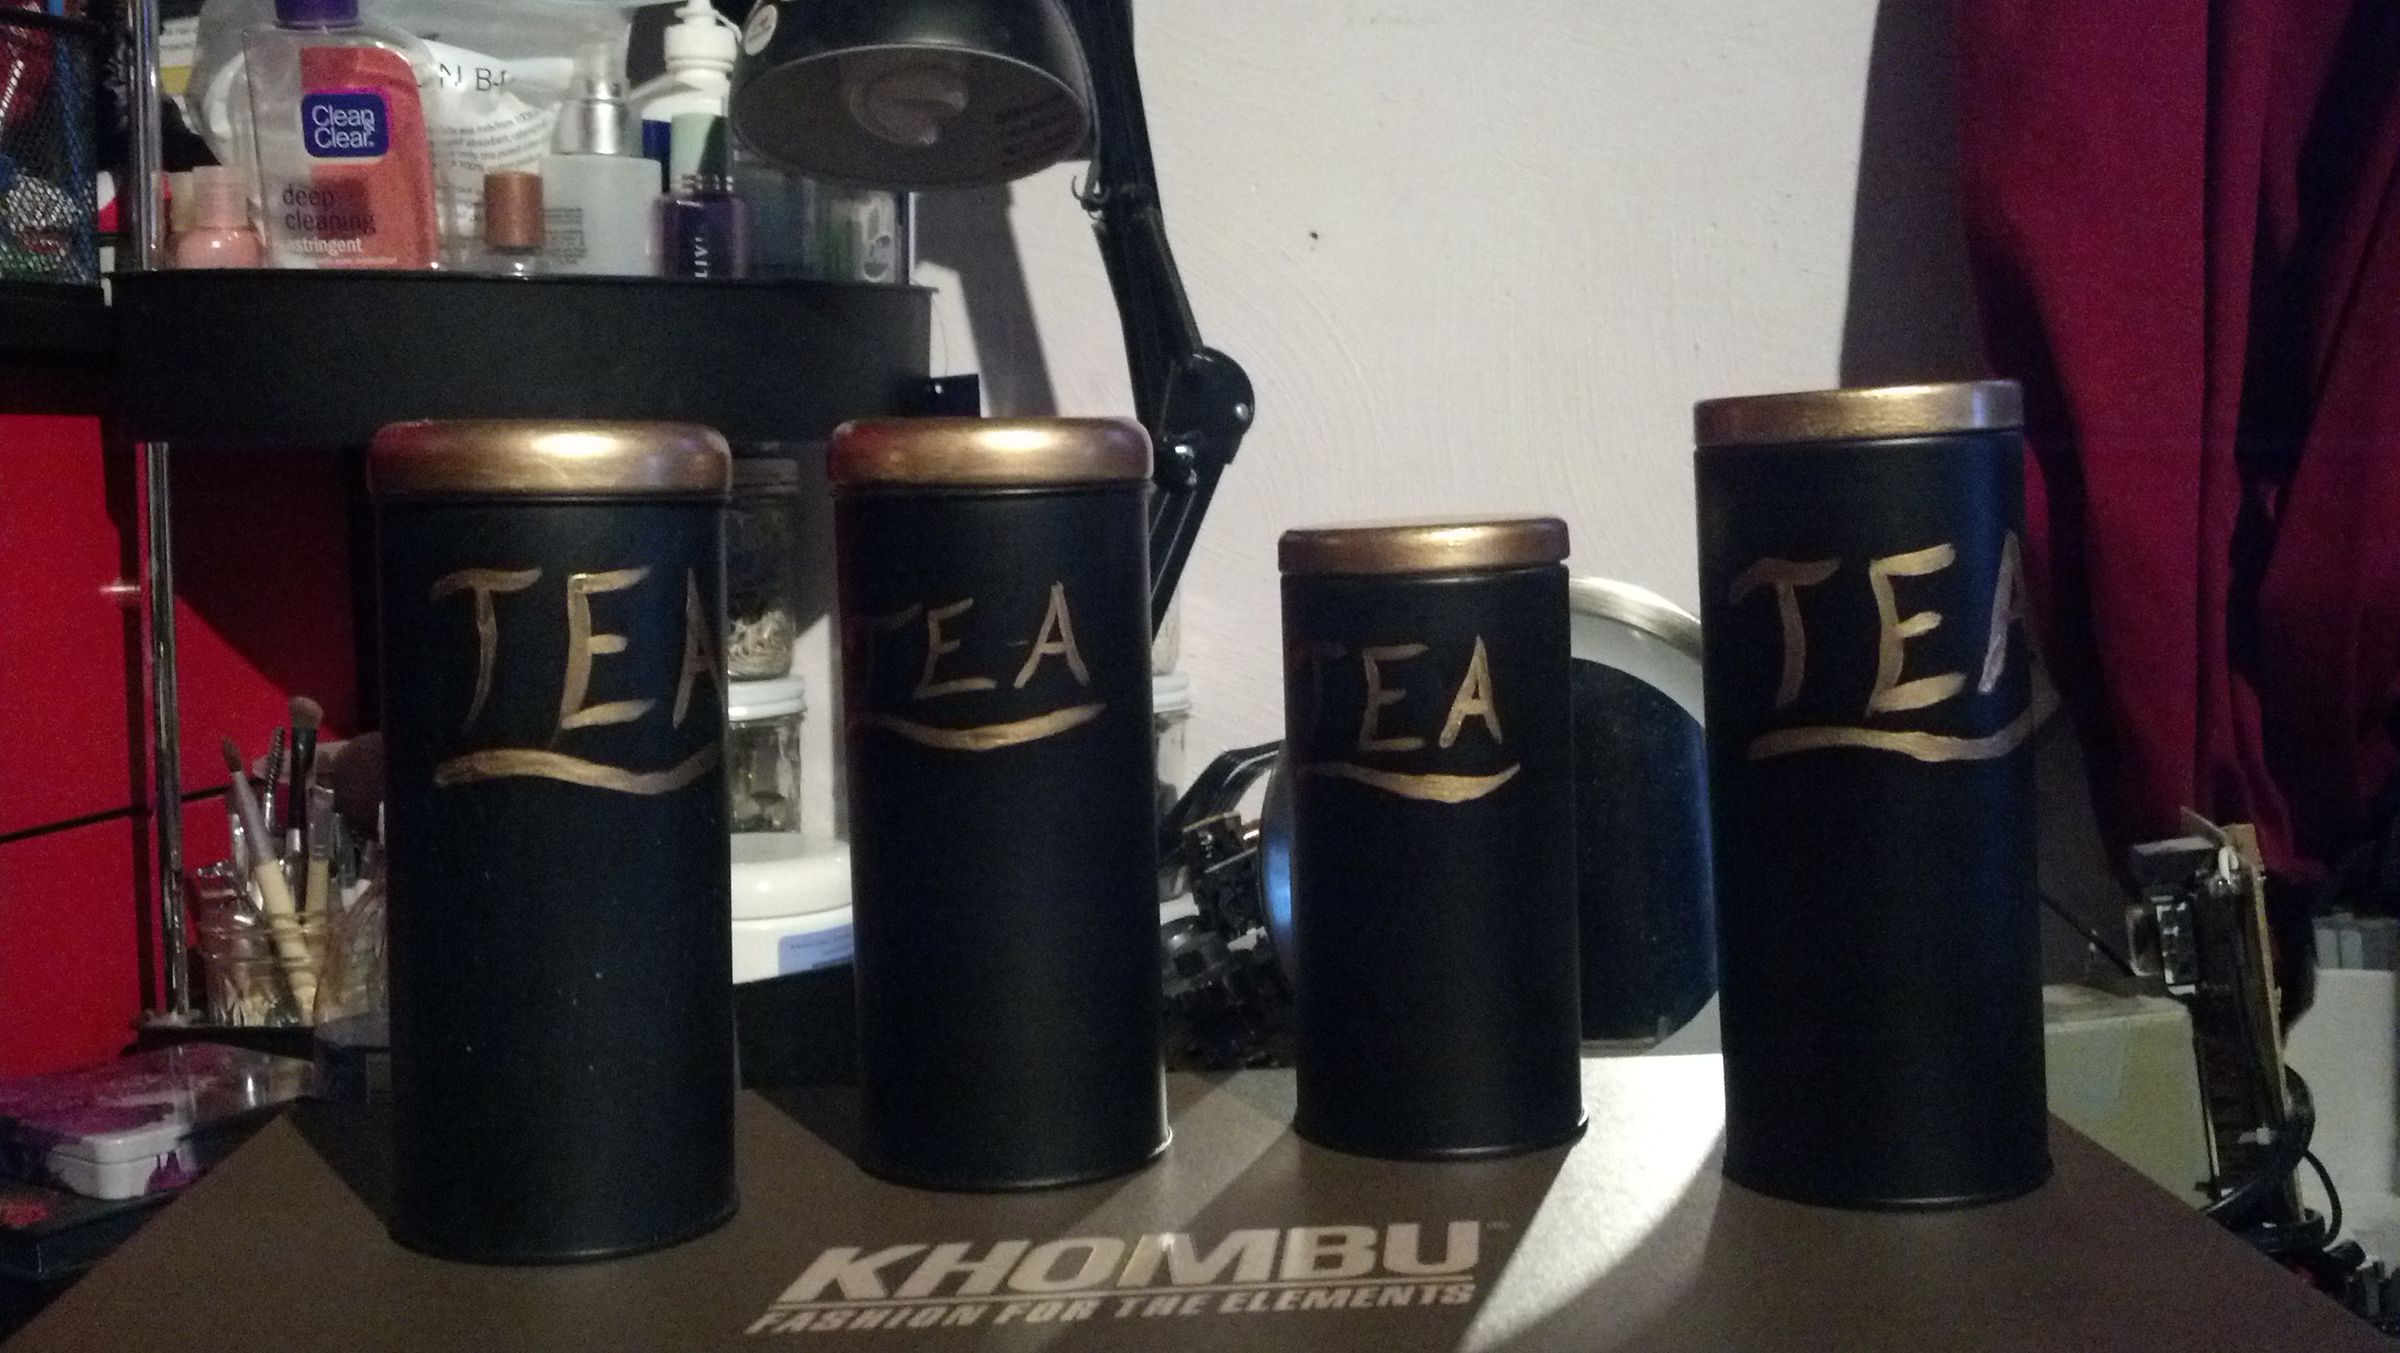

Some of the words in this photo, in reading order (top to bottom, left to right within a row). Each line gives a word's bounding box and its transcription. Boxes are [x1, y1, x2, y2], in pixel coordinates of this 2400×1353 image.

[311, 104, 375, 127] Clean
[313, 126, 371, 149] Clear
[282, 183, 334, 208] deep
[285, 210, 377, 236] cleaning
[1728, 529, 2056, 716] TEA
[429, 565, 724, 746] TEA
[775, 1221, 1480, 1302] KHOMBU
[745, 1303, 988, 1335] FASHION
[992, 1299, 1102, 1324] FOR
[1113, 1293, 1212, 1319] THE
[1218, 1283, 1476, 1315] ELEMENTS
